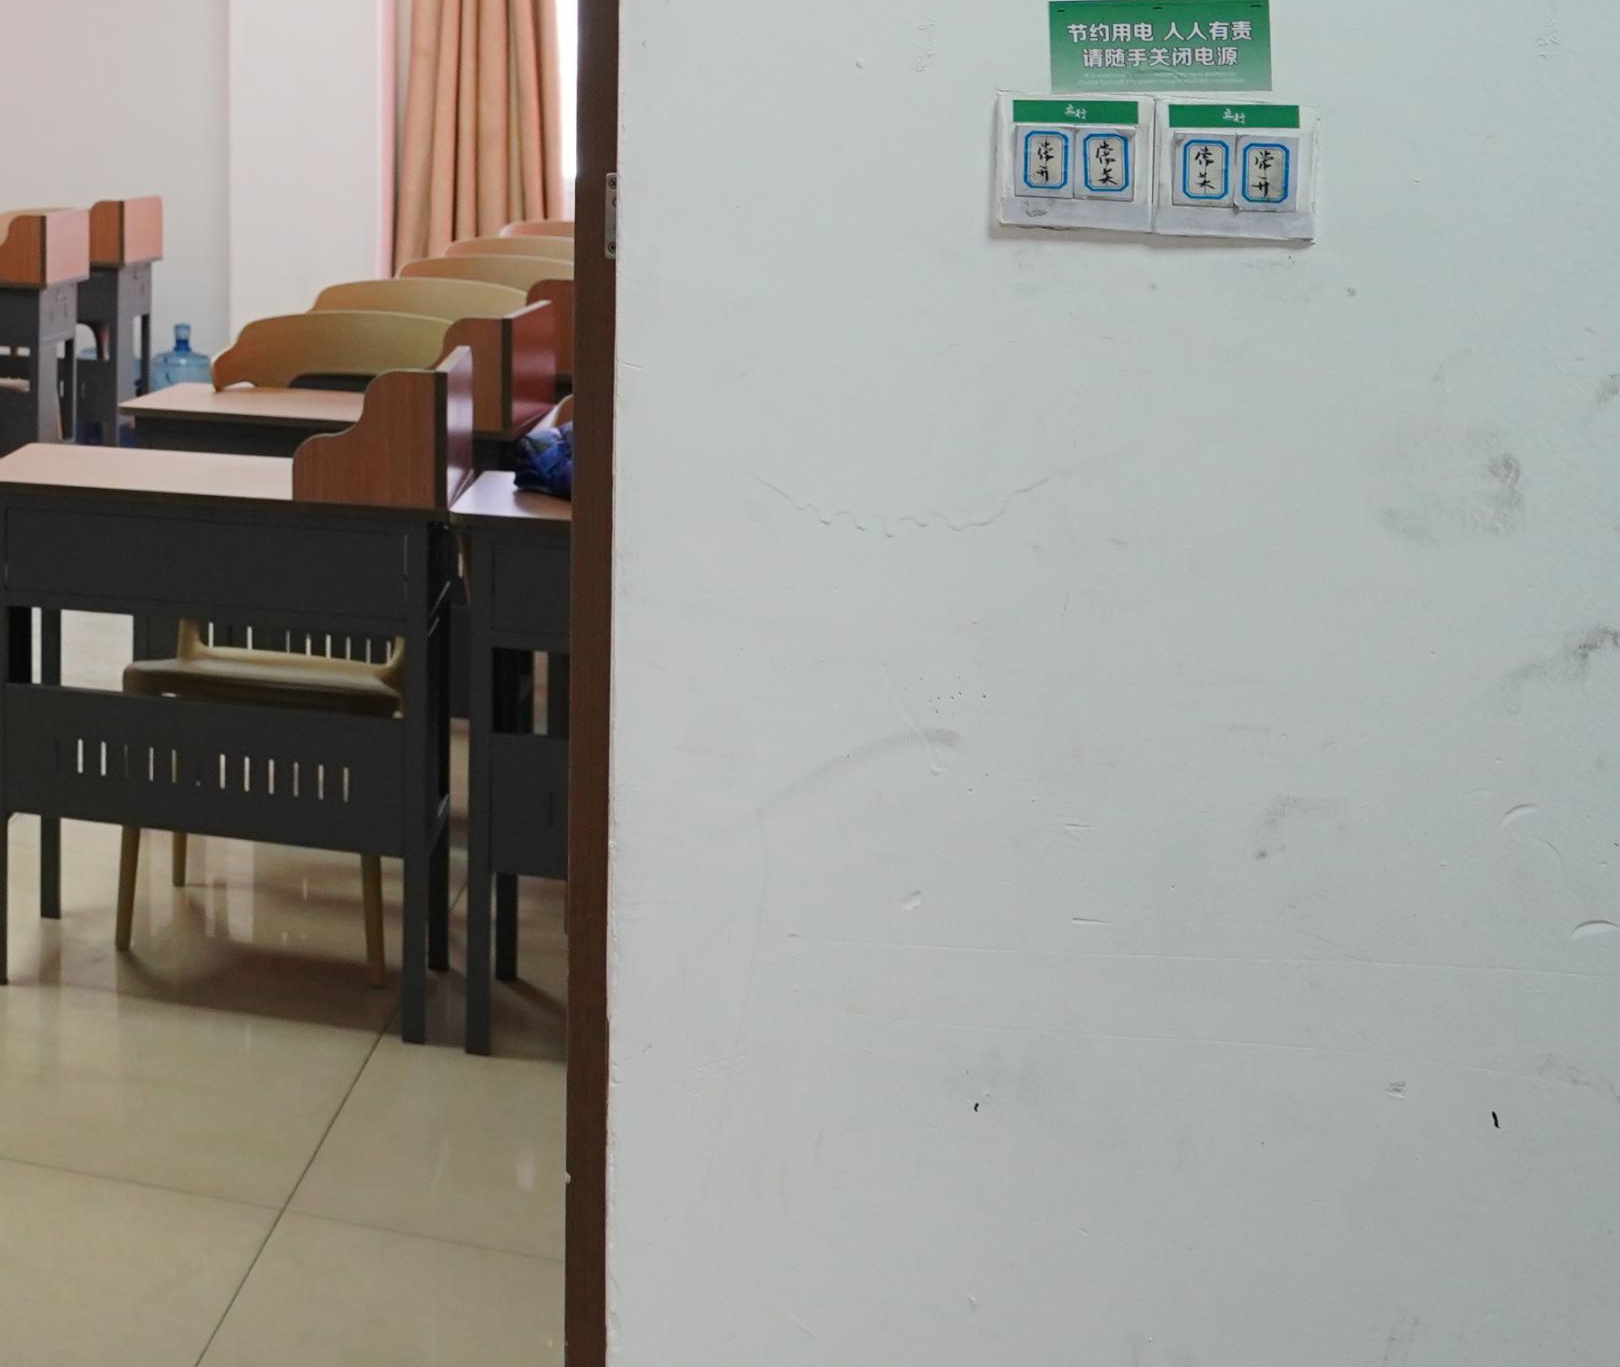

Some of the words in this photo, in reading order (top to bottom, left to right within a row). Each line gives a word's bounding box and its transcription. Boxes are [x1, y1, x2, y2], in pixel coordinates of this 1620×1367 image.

[1067, 23, 1154, 43] 节约用电
[1163, 20, 1253, 41] 人人有责
[1082, 46, 1238, 68] 请随手关闭电源
